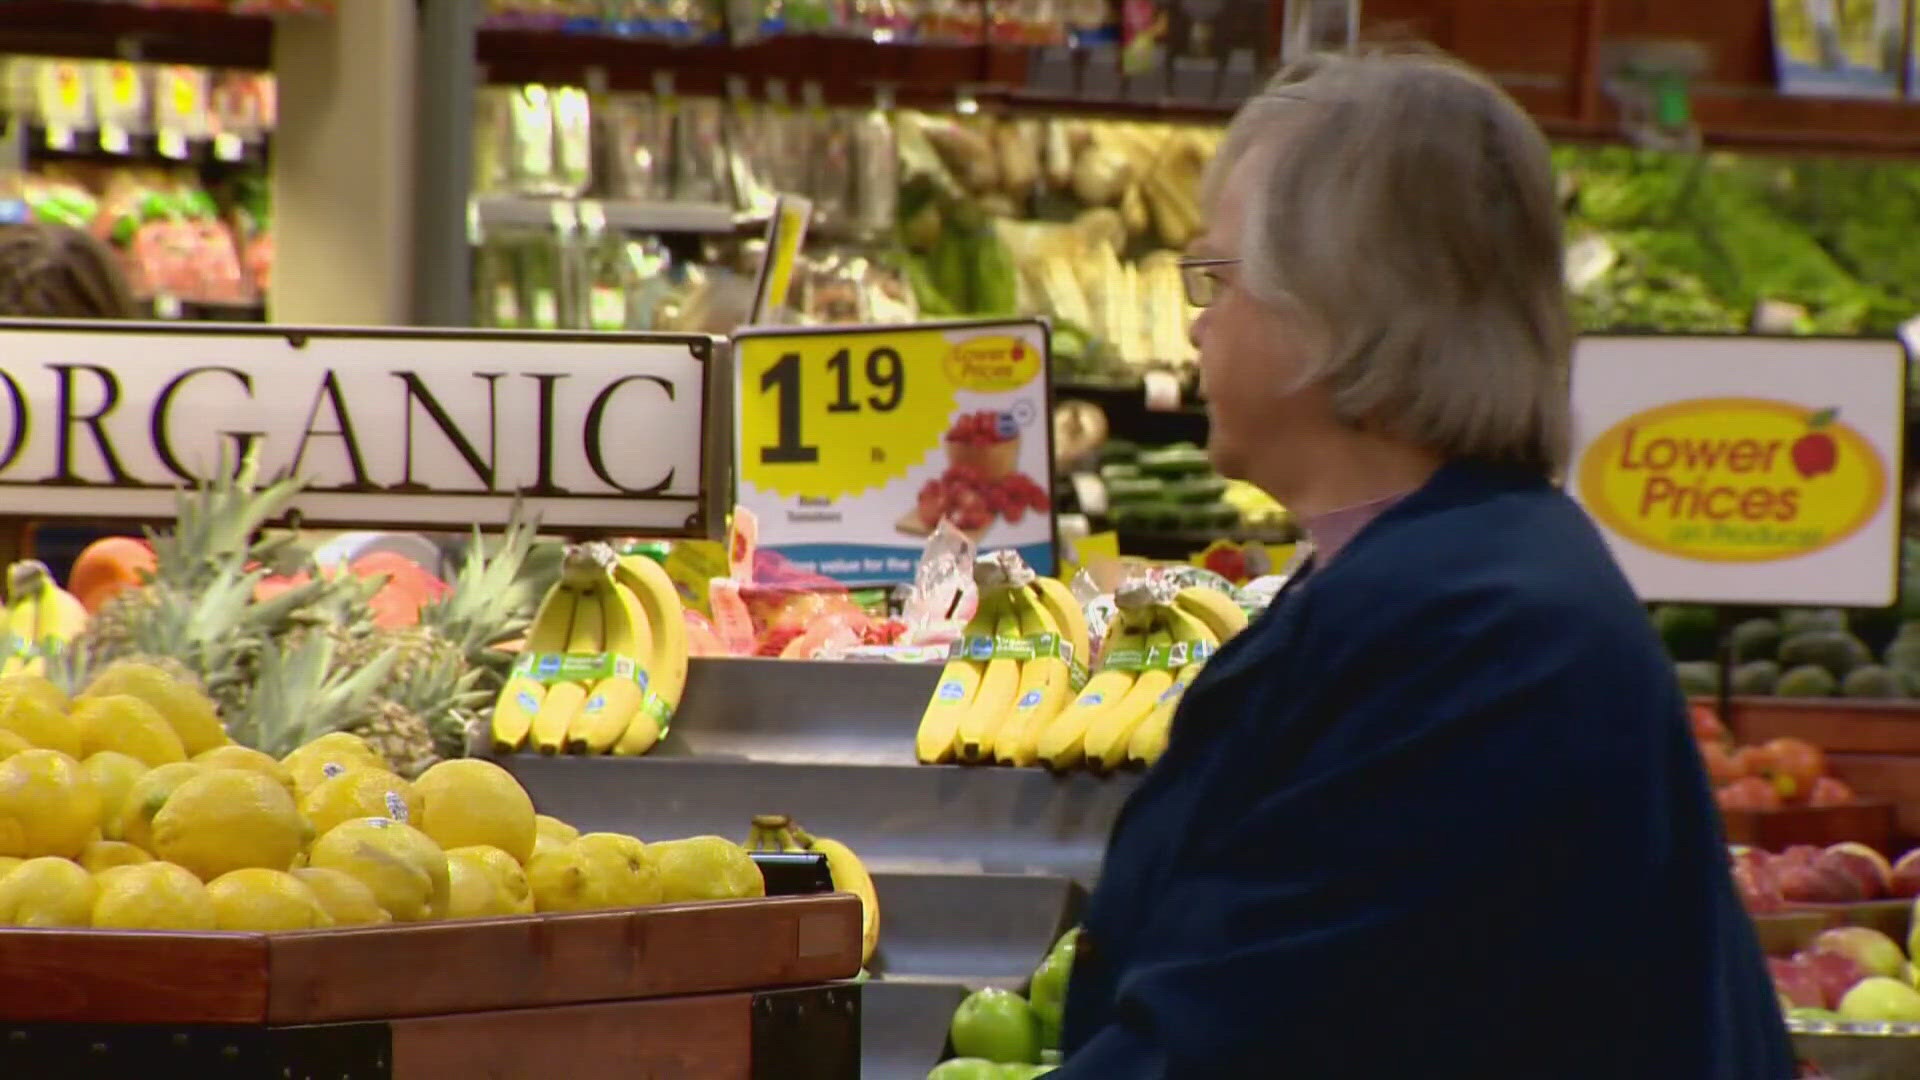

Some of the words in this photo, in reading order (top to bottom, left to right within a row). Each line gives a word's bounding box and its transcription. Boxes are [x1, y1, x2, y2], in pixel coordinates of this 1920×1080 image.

[0, 362, 677, 495] RGANIC
[1620, 427, 1783, 474] Lower
[1638, 476, 1801, 522] Prices
